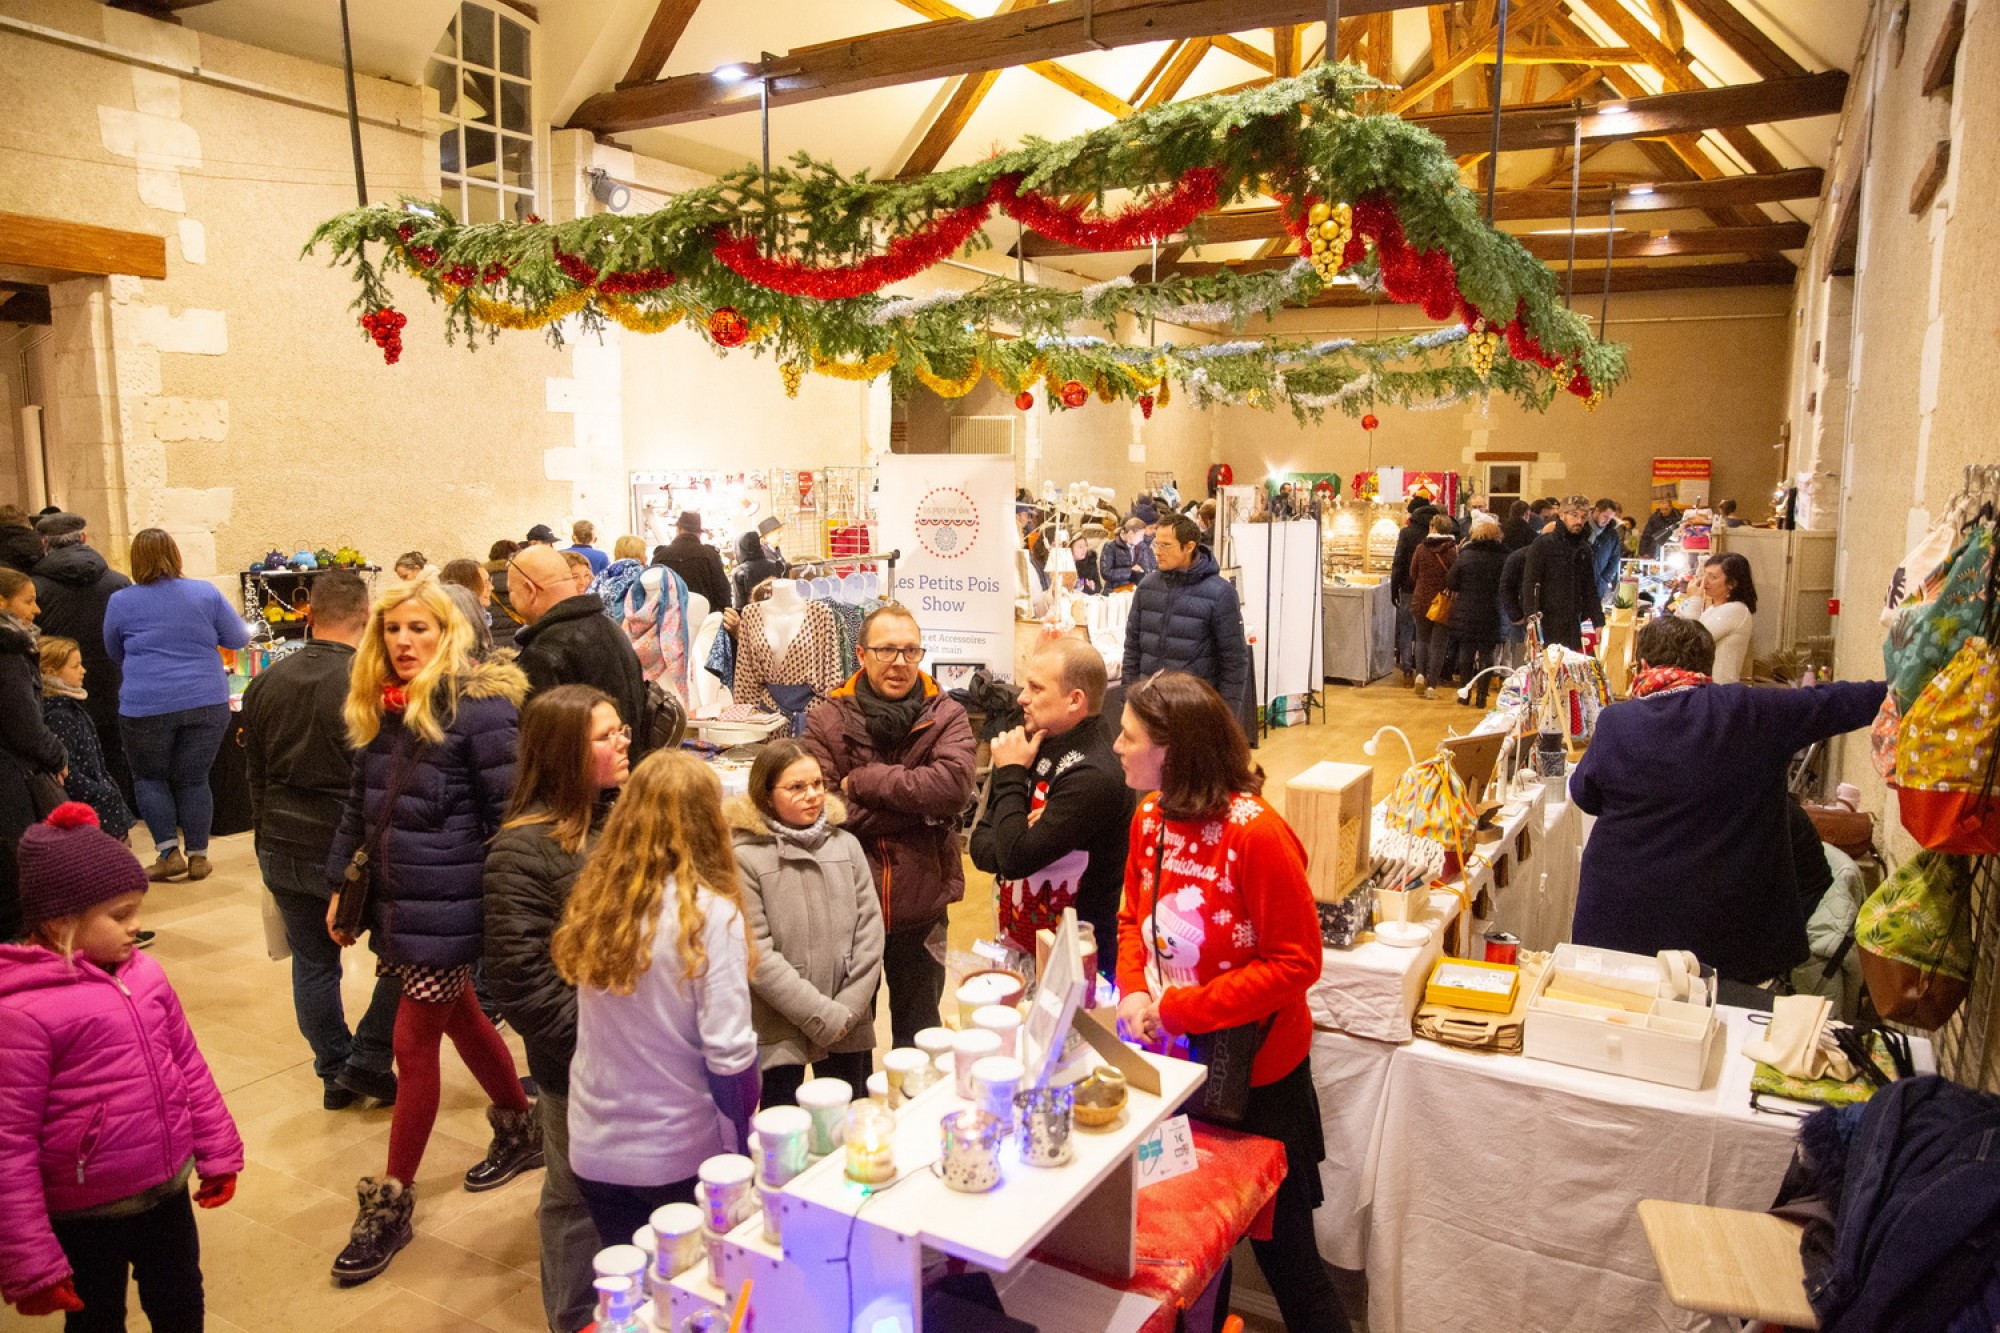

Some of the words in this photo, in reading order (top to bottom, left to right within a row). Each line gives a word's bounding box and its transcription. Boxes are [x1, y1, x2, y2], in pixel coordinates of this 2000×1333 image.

[919, 574, 964, 591] Petits
[967, 576, 1000, 593] Pois
[922, 595, 965, 612] Show
[928, 634, 936, 642] et
[939, 633, 986, 645] Accessoires
[992, 669, 1011, 681] how
[1160, 848, 1219, 881] Christmas
